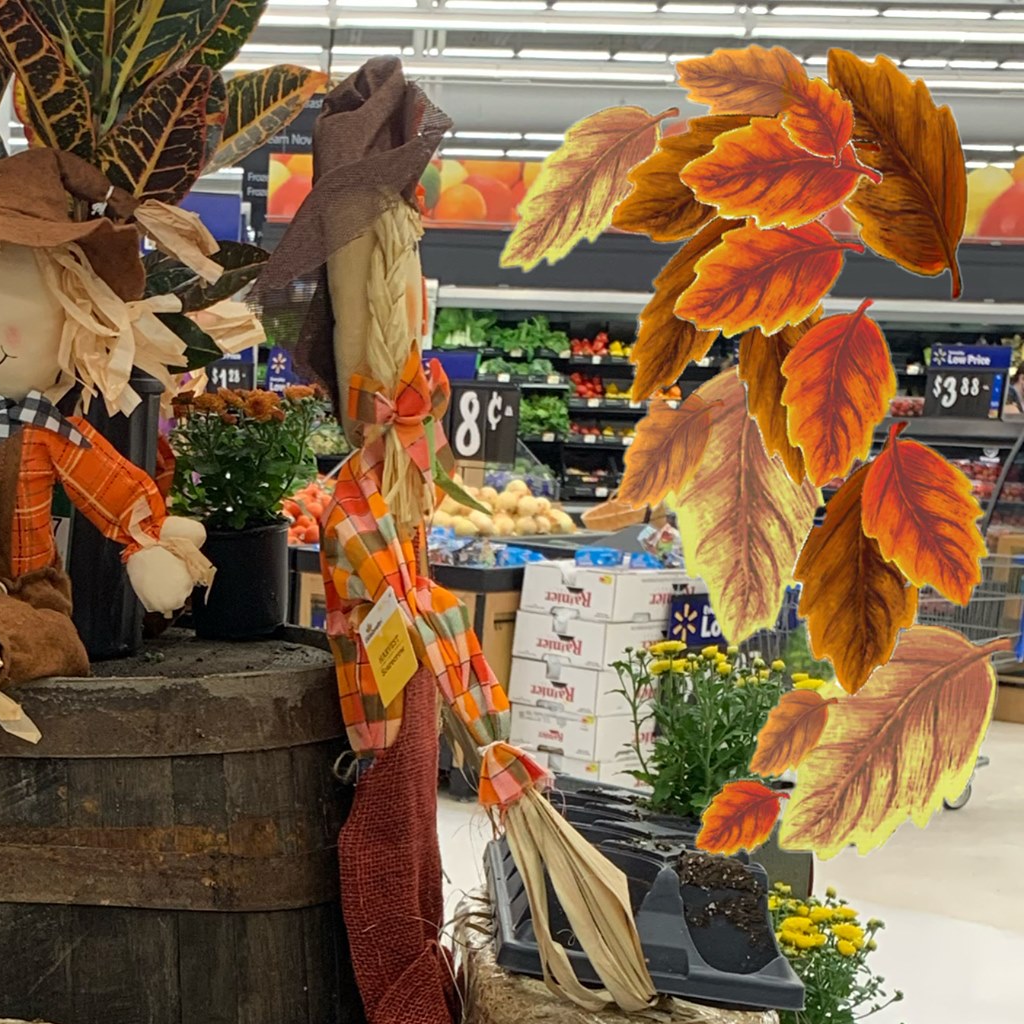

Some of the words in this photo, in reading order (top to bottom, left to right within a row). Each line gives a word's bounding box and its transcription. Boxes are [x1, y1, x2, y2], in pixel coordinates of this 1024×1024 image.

[291, 133, 313, 145] Nov
[947, 354, 967, 365] Low
[967, 354, 991, 366] Price
[544, 590, 593, 608] Rainier
[700, 616, 723, 639] Lo
[536, 637, 583, 656] Rainier
[530, 684, 576, 703] Rainier
